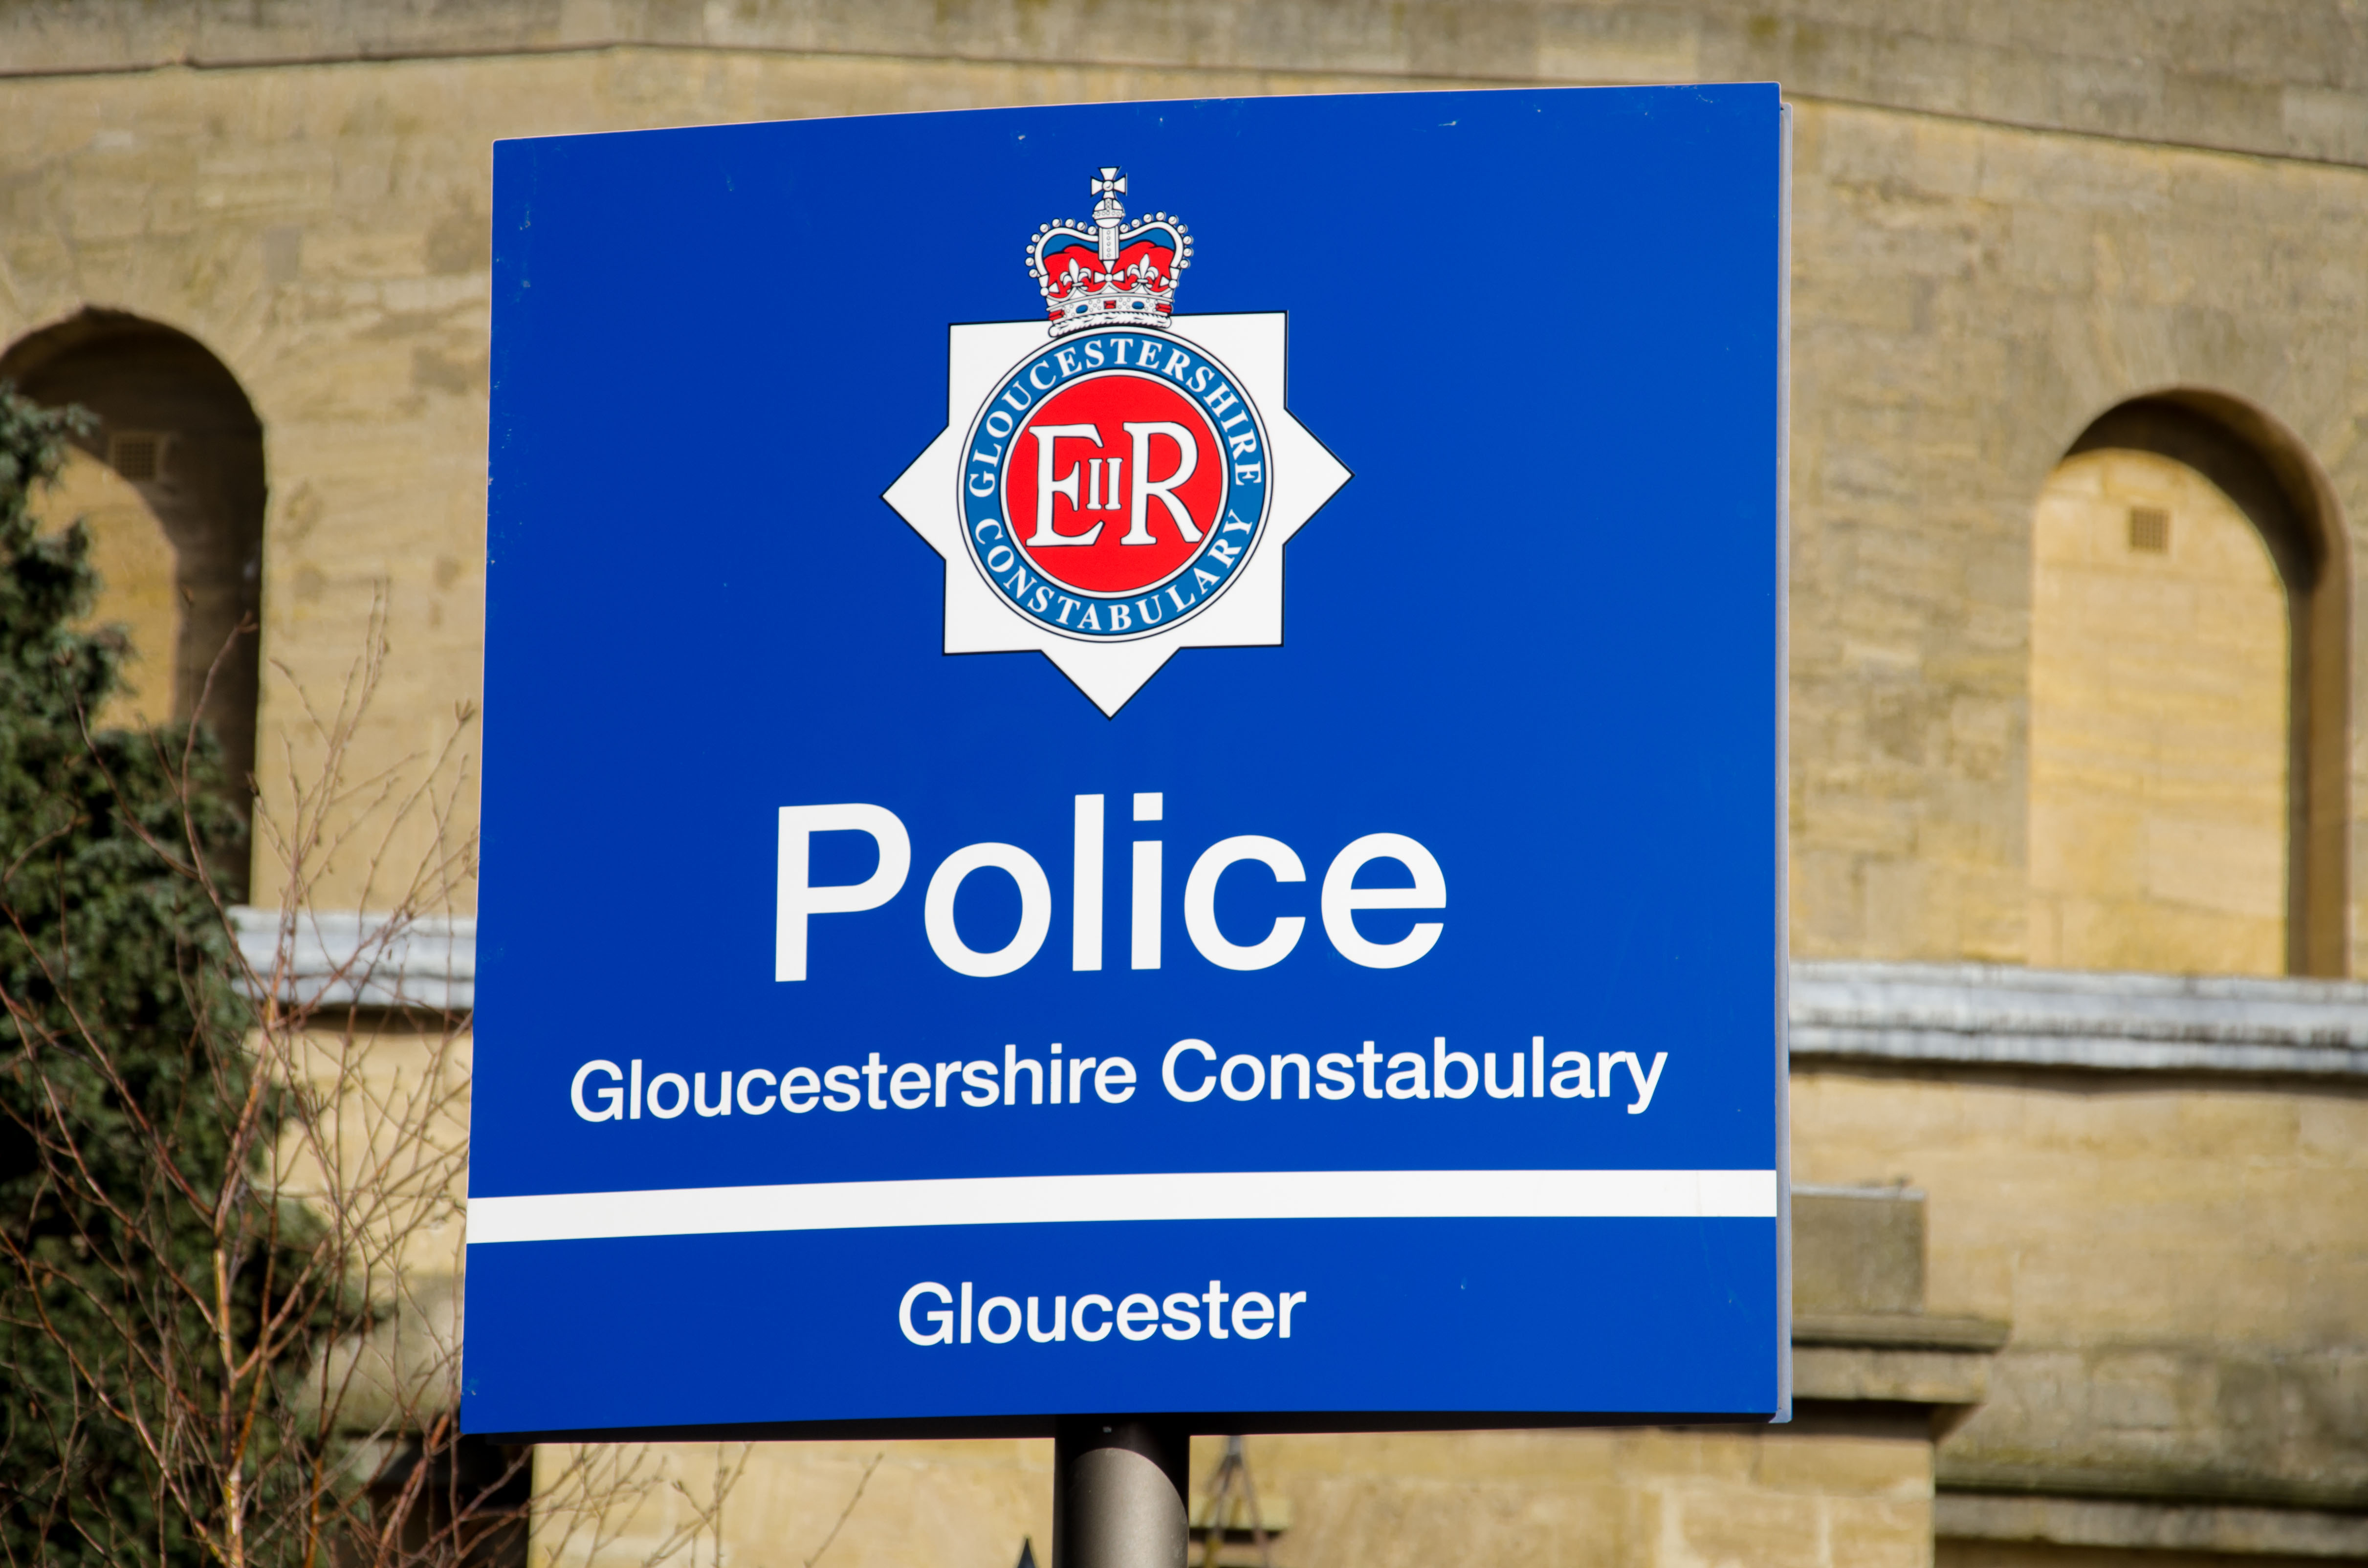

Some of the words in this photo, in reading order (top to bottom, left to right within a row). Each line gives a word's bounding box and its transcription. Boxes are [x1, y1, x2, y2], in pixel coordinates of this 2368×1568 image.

[968, 338, 1262, 498] GLOUCESTERSHIRE
[975, 509, 1253, 632] CONSTABULARY
[775, 792, 1447, 982] Police
[570, 1043, 1137, 1122] Gloucestershire
[1162, 1036, 1668, 1114] Constabulary
[899, 1280, 1307, 1346] Gloucester
